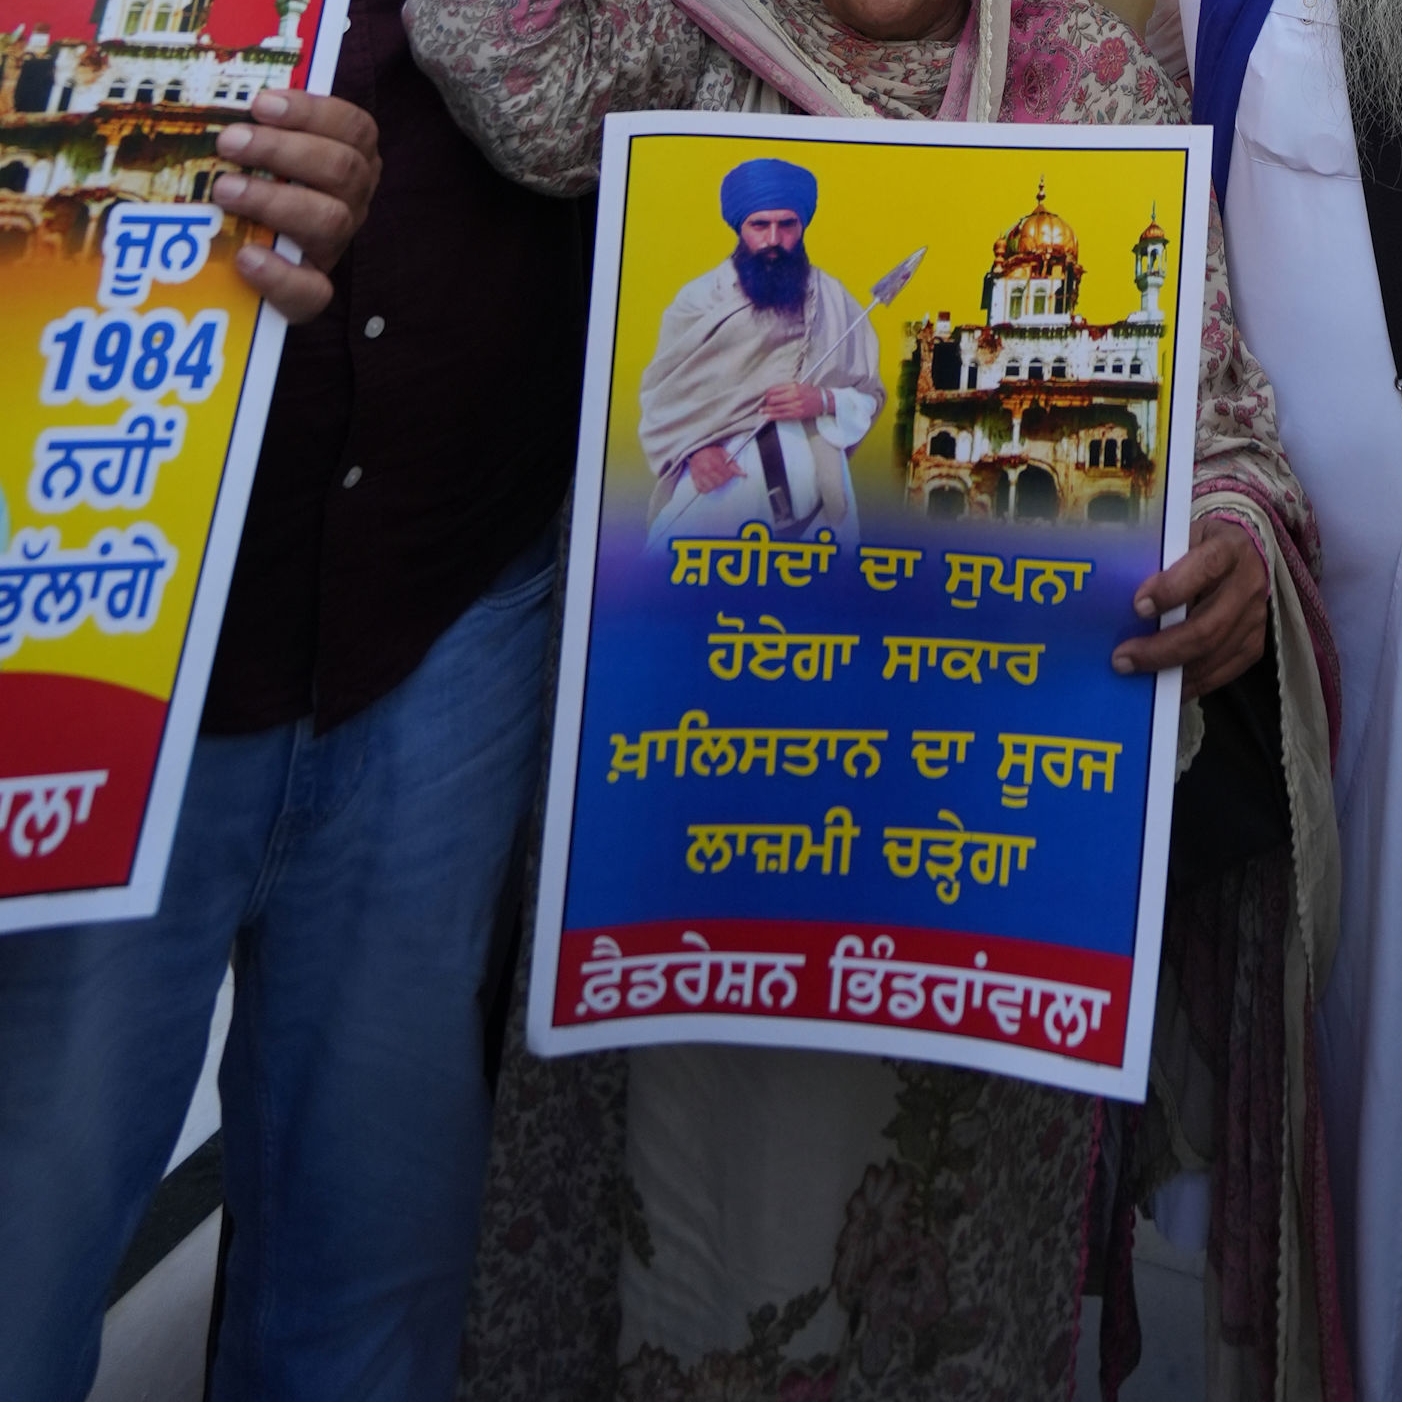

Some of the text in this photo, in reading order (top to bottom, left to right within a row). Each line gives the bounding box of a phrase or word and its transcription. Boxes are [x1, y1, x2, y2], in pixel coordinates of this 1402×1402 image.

[110, 215, 213, 296] ਜੂਨ
[52, 320, 219, 392] 1984
[40, 414, 177, 499] ਨਹੀਂ
[670, 523, 1092, 609] ਸ਼ਹੀਦਾਂ ਦਾ ਸੁਪਨਾ
[707, 611, 1046, 686] ਹੋਏਗਾ ਸਾਕਾਰ
[606, 709, 1123, 808] ਖ਼ਾਲਿਸਤਾਨ ਦਾ ਸੂਰਜ
[685, 806, 1036, 905] ਲਾਜ਼ਮੀ ਚੜ੍ਹੇਗਾ
[574, 930, 1112, 1048] ਫ਼ੈਡਰੇਸ਼ਨ ਭਿੰਡਰਾਂਵਾਲਾ
